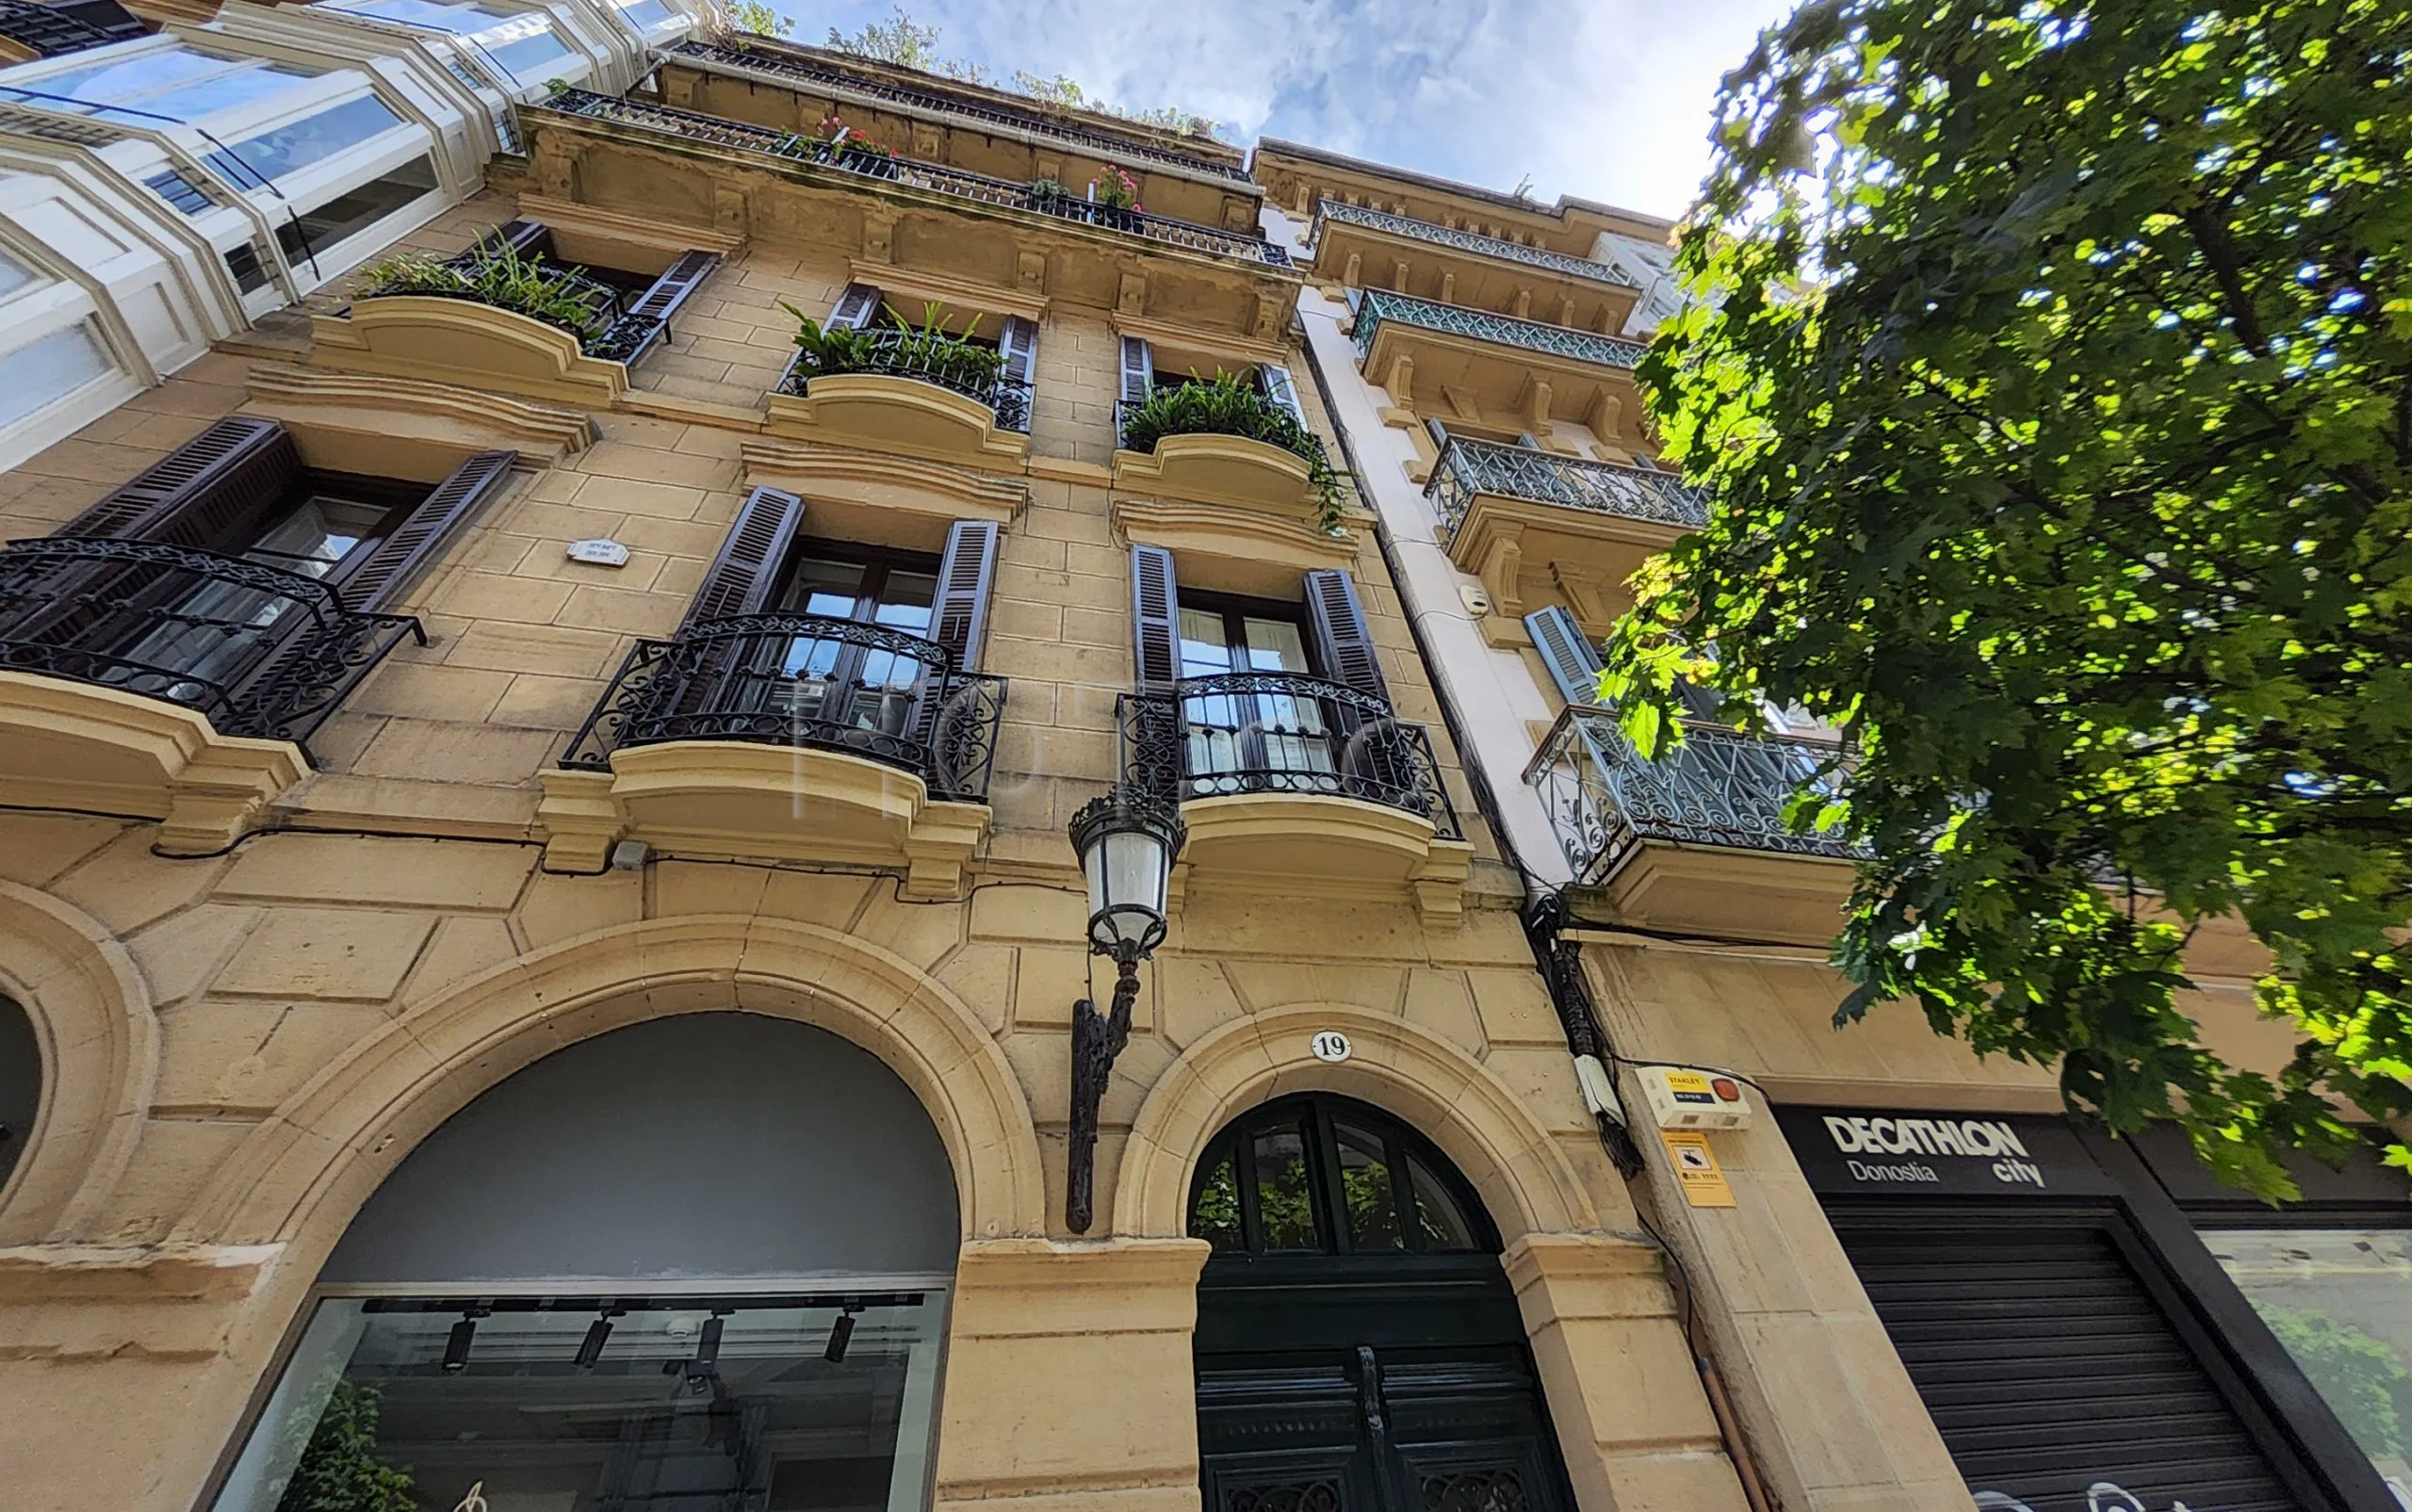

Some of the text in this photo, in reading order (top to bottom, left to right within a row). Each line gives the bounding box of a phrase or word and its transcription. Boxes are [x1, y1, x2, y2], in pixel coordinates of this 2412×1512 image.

[1318, 1035, 1345, 1056] 19
[1821, 1115, 2031, 1158] DECATHLON
[1846, 1160, 1940, 1182] Donostia
[1992, 1158, 2046, 1189] city
